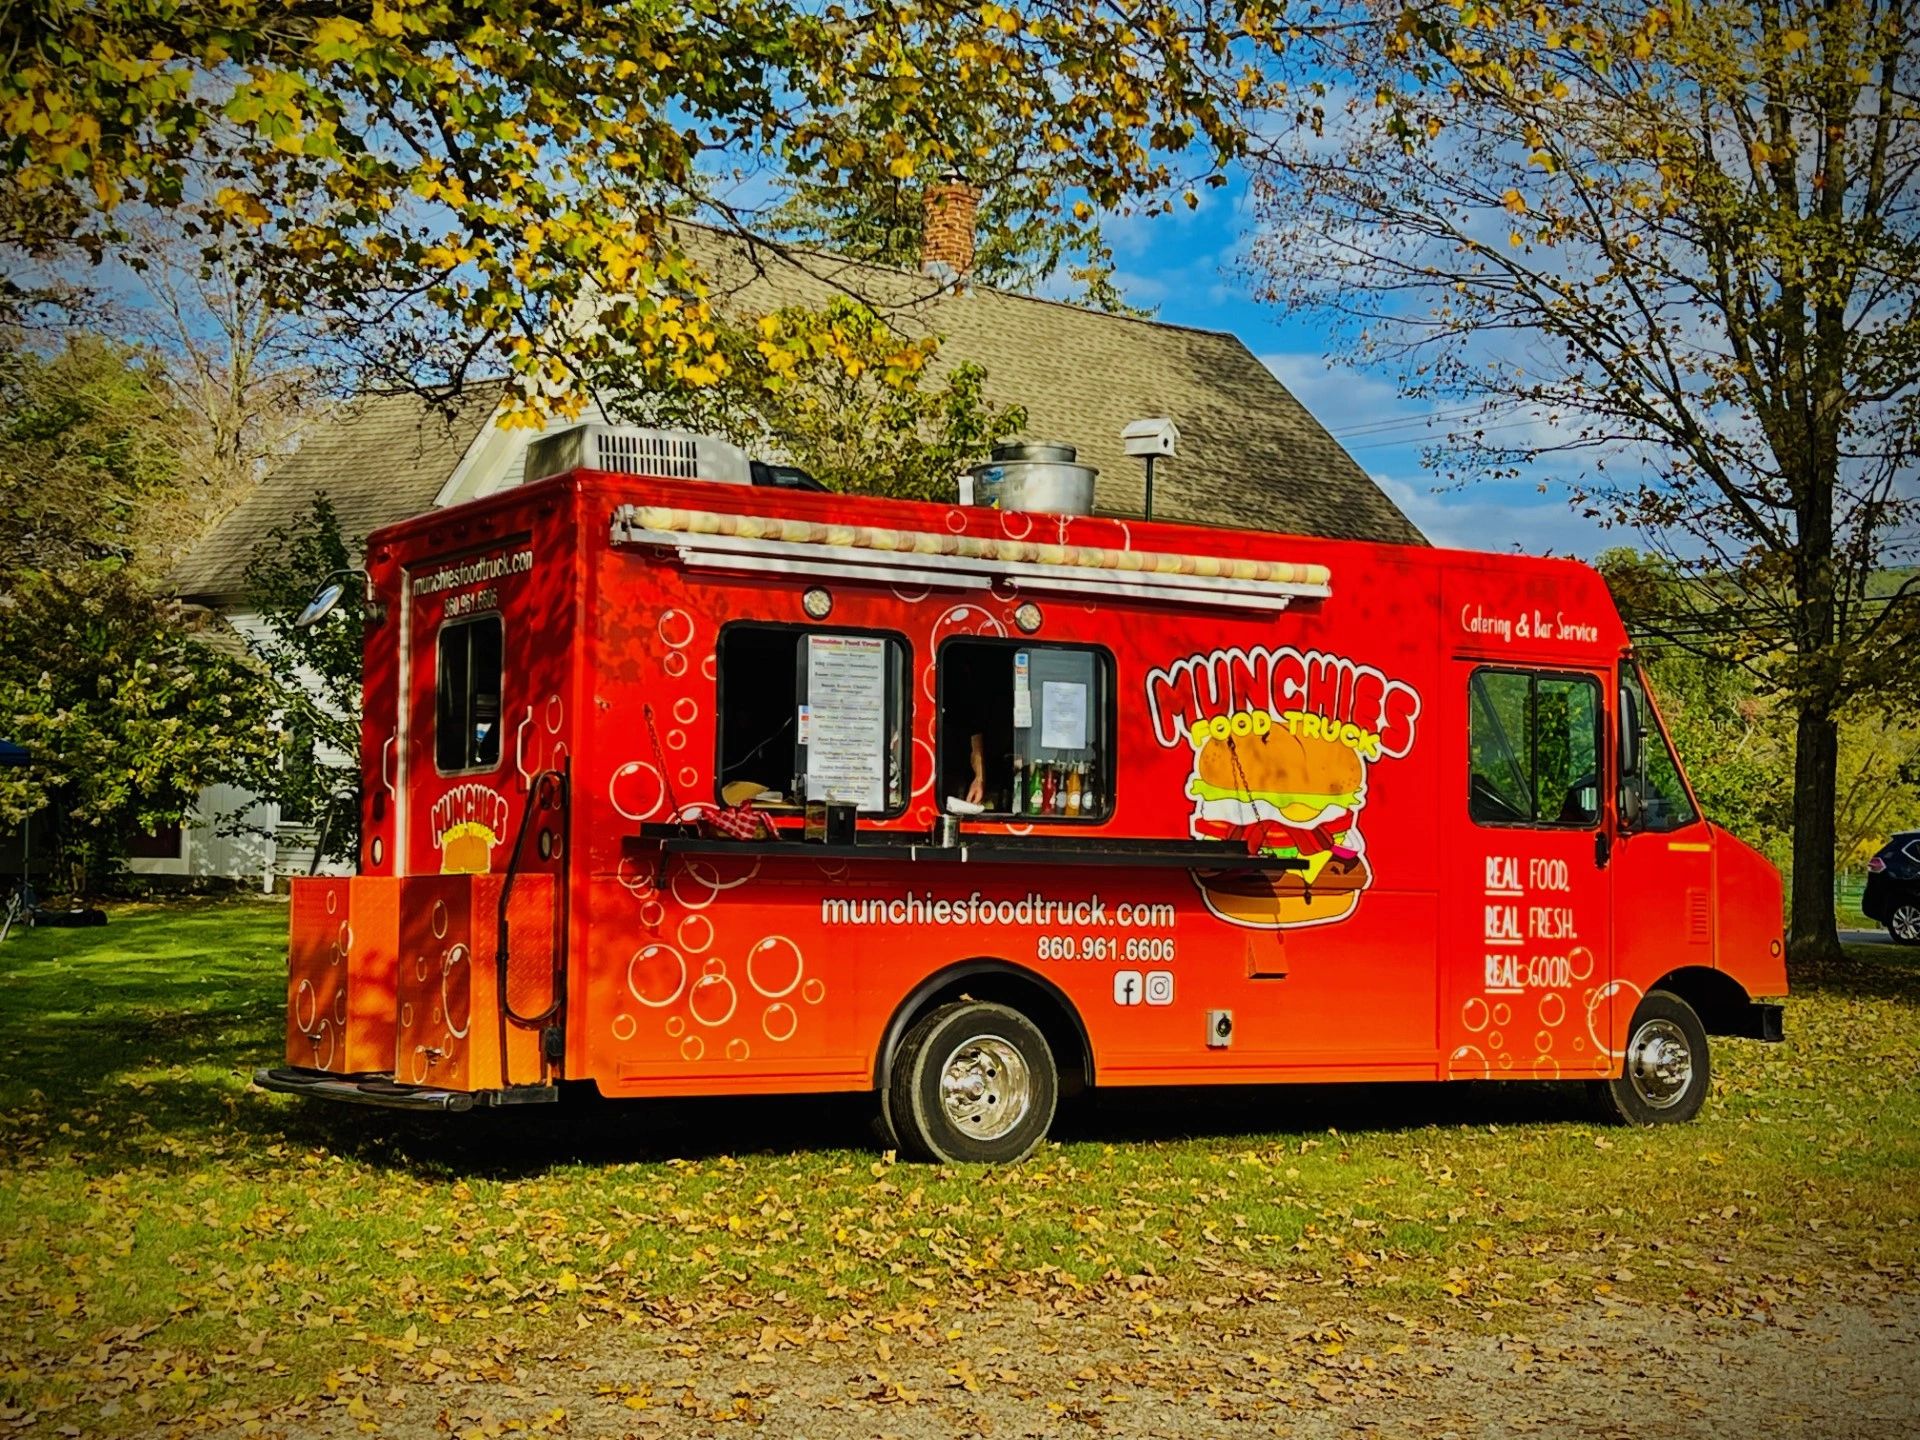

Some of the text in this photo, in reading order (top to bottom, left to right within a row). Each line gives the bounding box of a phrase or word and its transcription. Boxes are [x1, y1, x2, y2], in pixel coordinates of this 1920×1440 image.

[1461, 603, 1598, 643] Catering & Bar Service
[1146, 646, 1421, 759] MUNCHIES
[1190, 710, 1380, 758] FOOD TRUCK
[1485, 856, 1570, 892] REAL FOOD.
[821, 891, 1176, 927] munchiesfoodtruck.com
[1484, 905, 1578, 939] REAL FRESH.
[1037, 935, 1175, 962] 860.961.6606
[1484, 954, 1523, 987] REAL
